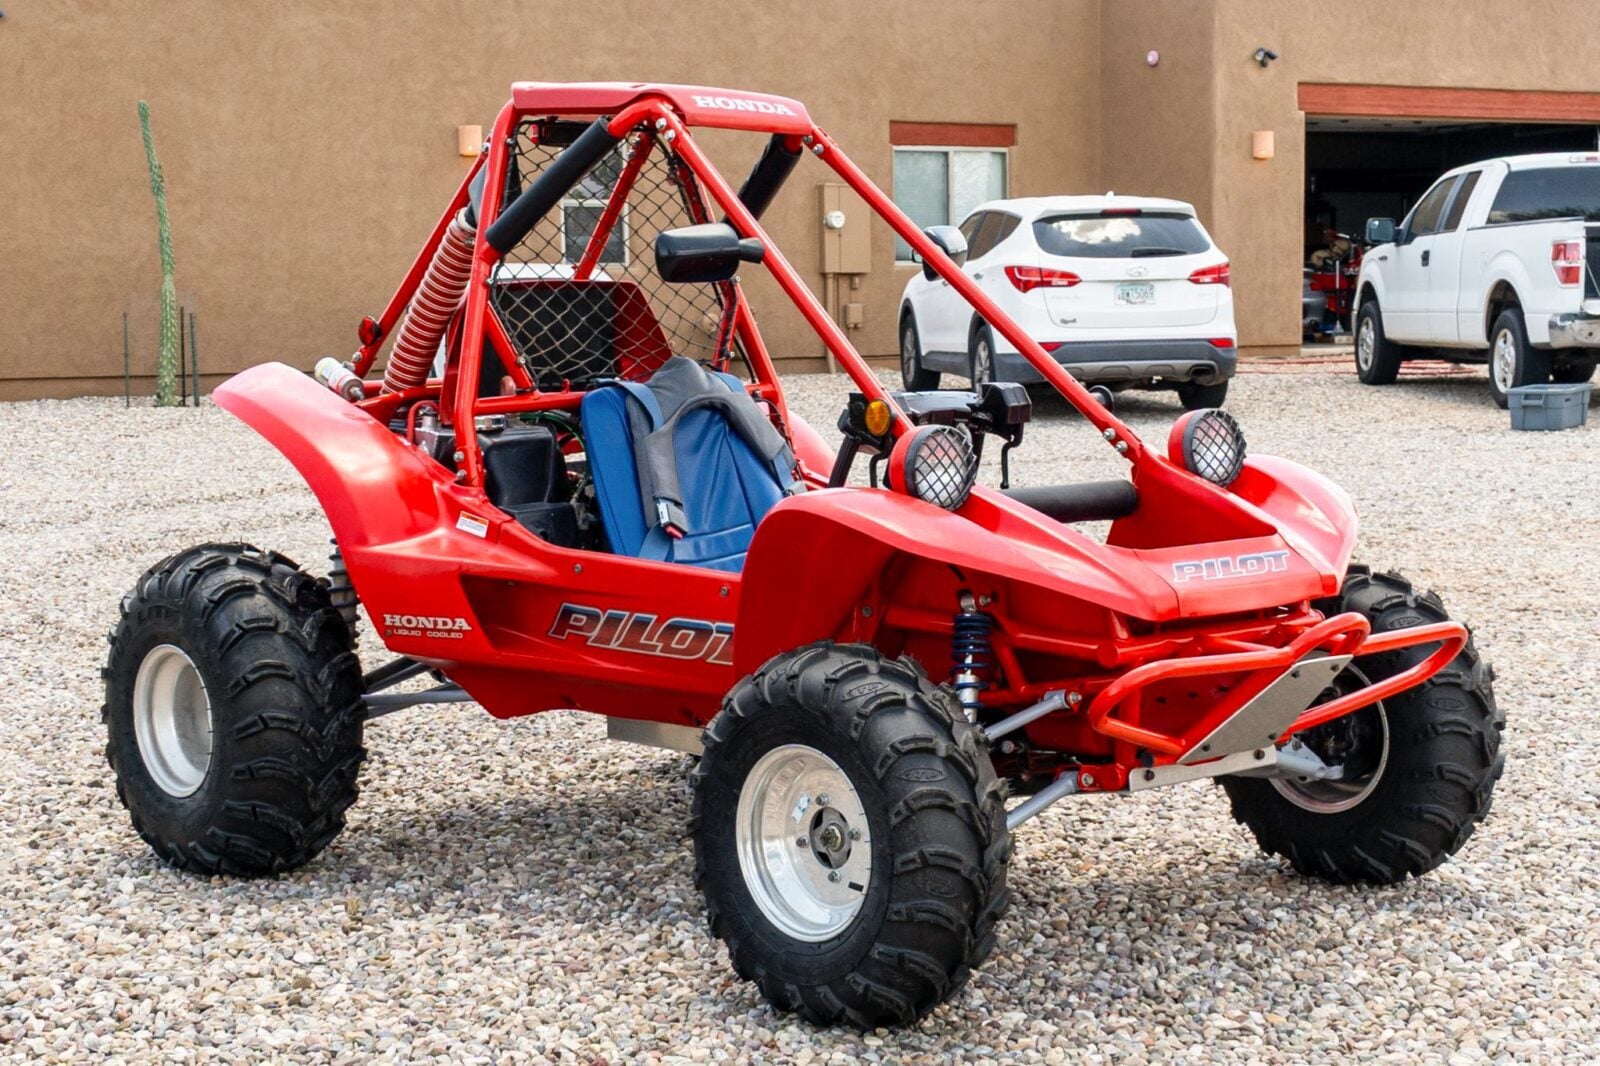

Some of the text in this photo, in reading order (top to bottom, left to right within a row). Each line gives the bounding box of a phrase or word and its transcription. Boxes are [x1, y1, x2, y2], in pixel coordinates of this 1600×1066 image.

[691, 95, 797, 116] HONDA
[1172, 549, 1290, 583] PILOT
[383, 613, 472, 631] HONDA
[393, 628, 464, 639] LIQUID COOLED
